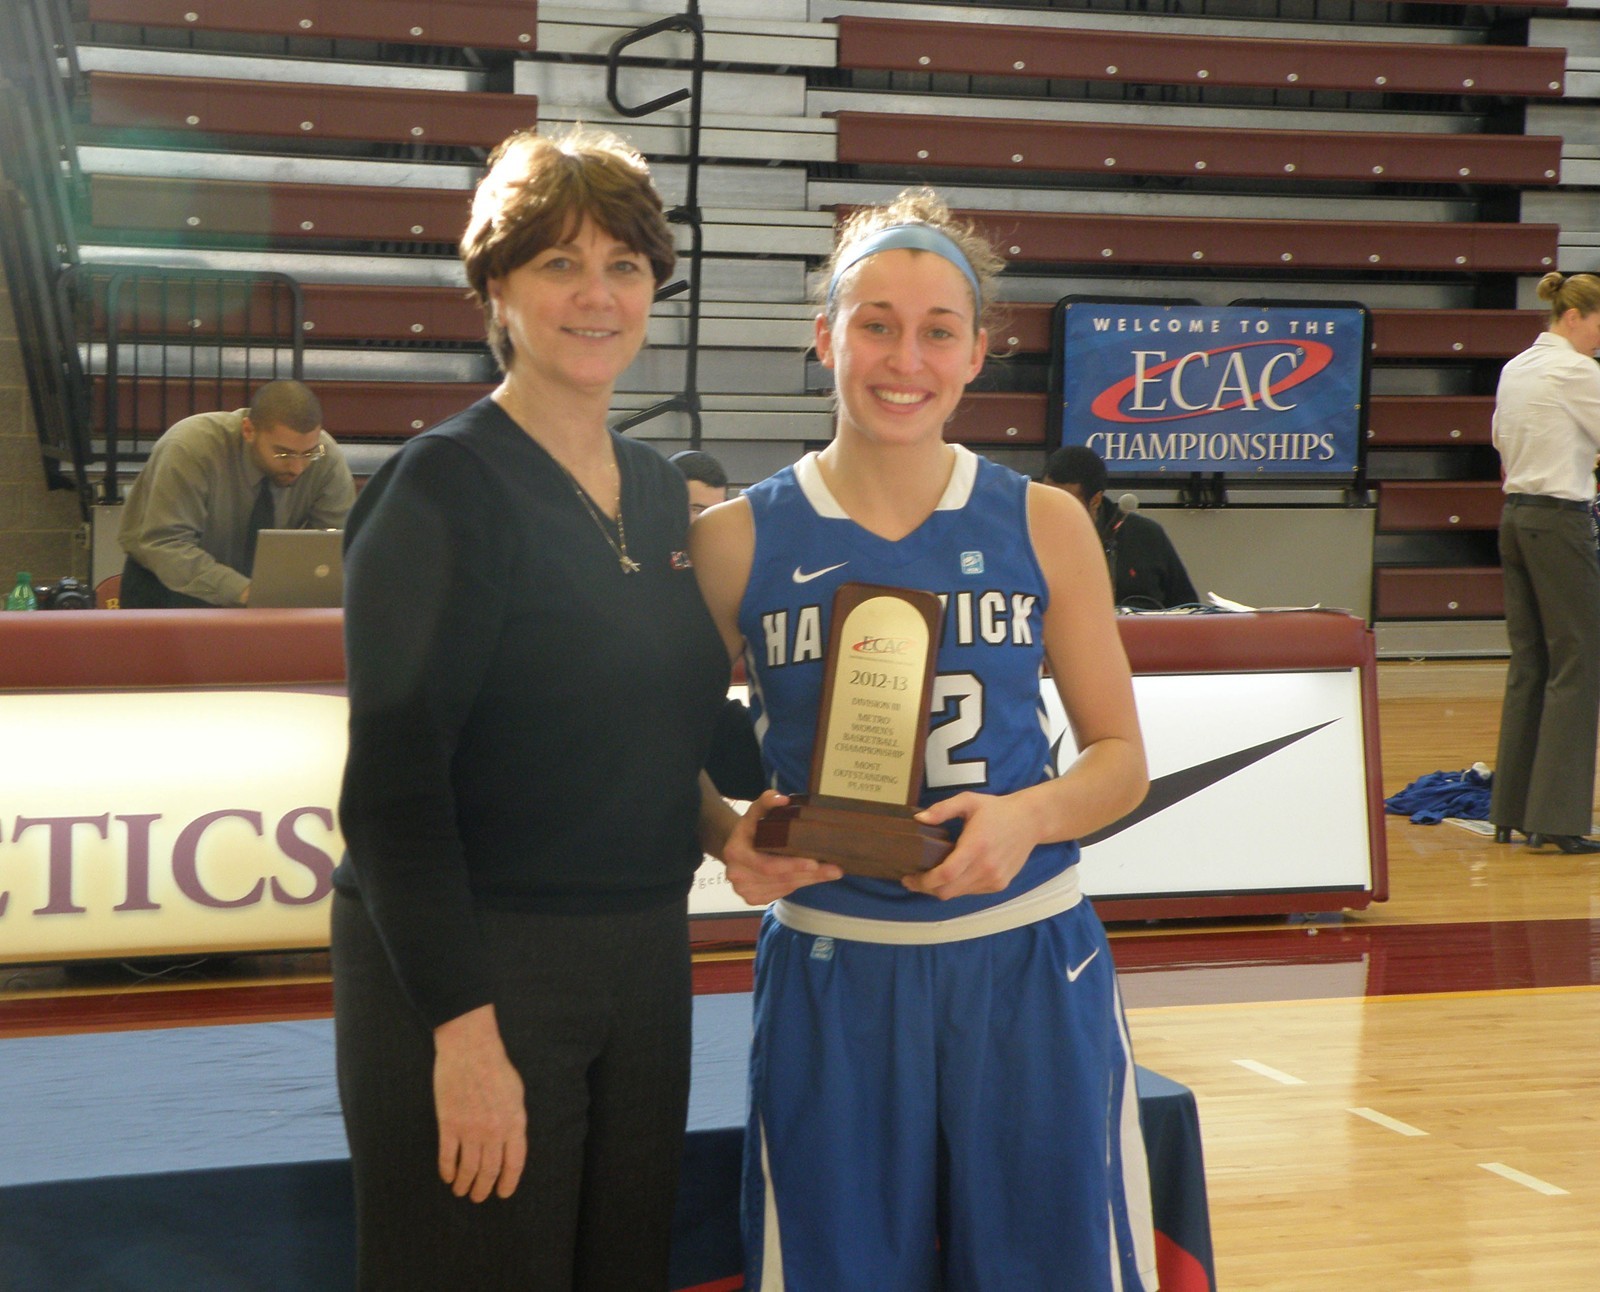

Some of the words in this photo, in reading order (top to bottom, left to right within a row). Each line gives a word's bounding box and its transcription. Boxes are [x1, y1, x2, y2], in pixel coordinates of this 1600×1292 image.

[1093, 318, 1220, 334] WELCOME
[1240, 320, 1270, 334] TO
[1290, 321, 1335, 335] THE
[1129, 350, 1298, 412] ECAC
[1085, 432, 1335, 461] CHAMPIONSHIPS
[762, 590, 1039, 667] HAICK
[849, 669, 909, 691] 2012-13
[851, 697, 890, 709] DIVISION
[858, 713, 891, 724] METRO
[842, 732, 899, 747] BASKETBALL
[834, 742, 905, 758] CHAMPIONSHIP
[855, 760, 881, 771] MOST
[833, 769, 898, 784] OUTSTANDING
[847, 781, 881, 792] PLAYER
[0, 806, 337, 916] TICS
